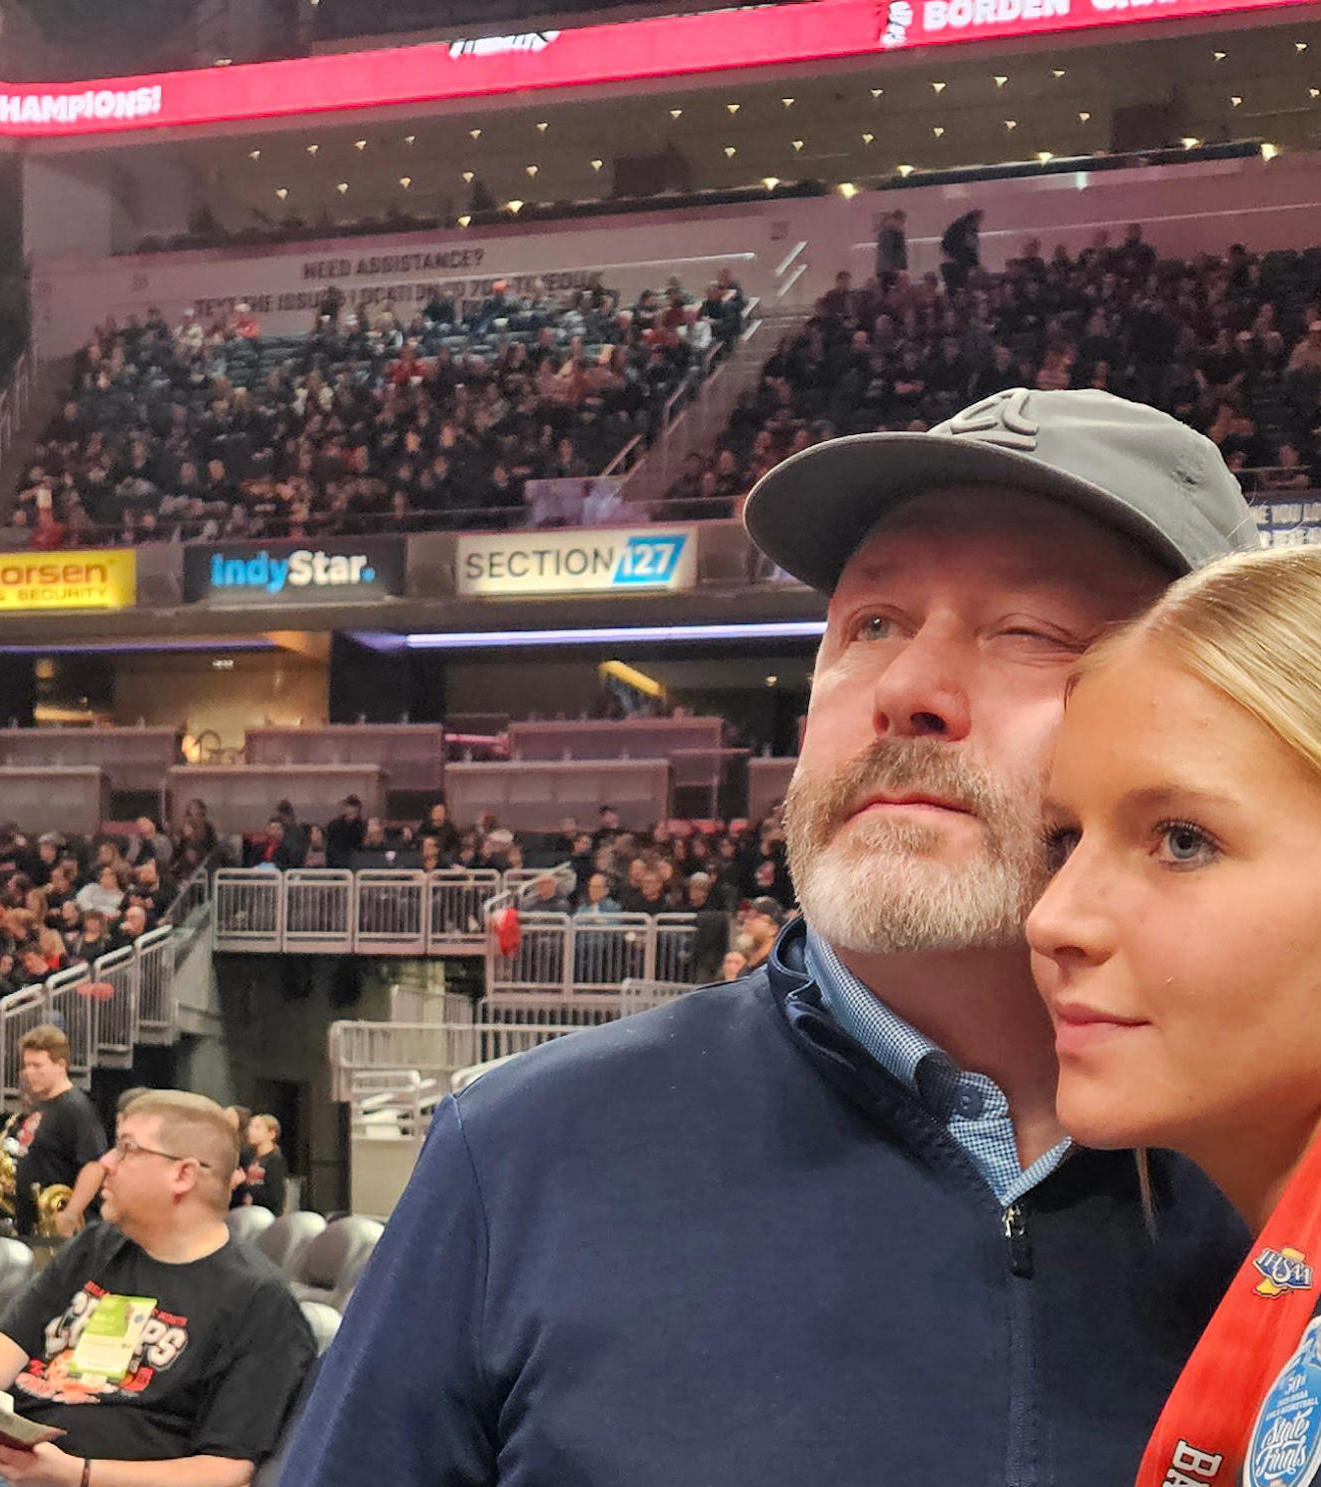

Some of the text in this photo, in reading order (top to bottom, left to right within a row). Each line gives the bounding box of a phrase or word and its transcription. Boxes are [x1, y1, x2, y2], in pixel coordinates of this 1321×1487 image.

[303, 259, 352, 280] NEED
[466, 543, 675, 580] SECTION 127
